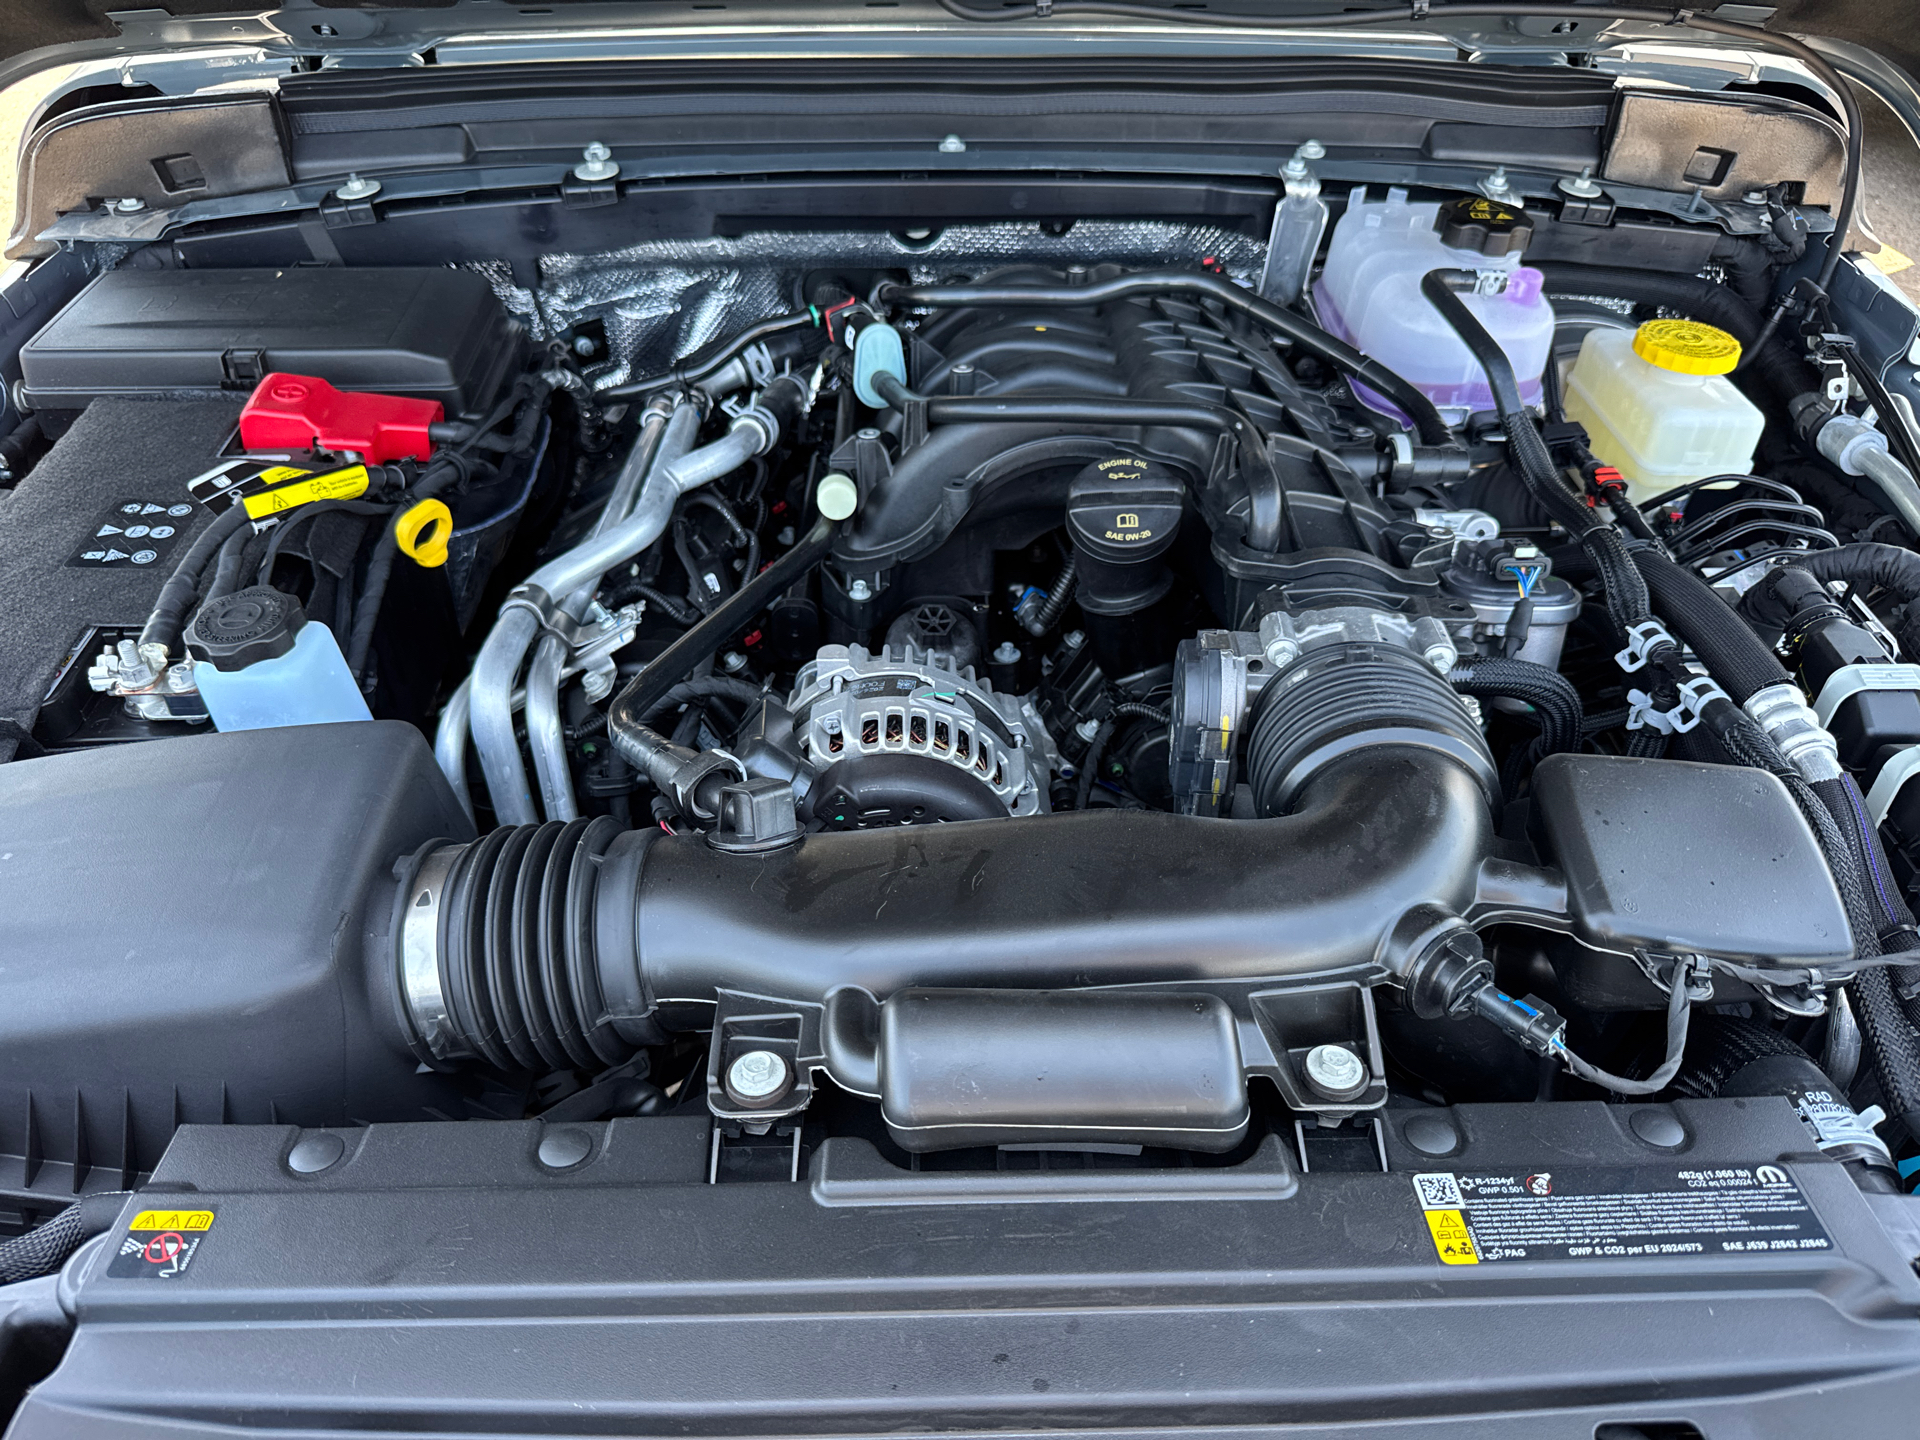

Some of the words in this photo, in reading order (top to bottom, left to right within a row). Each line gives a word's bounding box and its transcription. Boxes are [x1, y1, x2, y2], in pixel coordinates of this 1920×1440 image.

[1097, 458, 1132, 471] ENGINE
[1133, 459, 1148, 470] OIL
[1105, 530, 1124, 541] SAE
[1125, 529, 1152, 541] 0W-20
[1804, 1091, 1833, 1103] RAD
[1474, 1176, 1515, 1186] R-1234yf
[1677, 1171, 1704, 1181] 482g
[1735, 1169, 1752, 1179] lb)
[1688, 1179, 1708, 1188] CO2
[1478, 1186, 1500, 1195] GWP
[1501, 1185, 1525, 1194] 0.501
[1568, 1246, 1592, 1256] GWP
[1594, 1247, 1603, 1255] &
[1604, 1245, 1625, 1255] CO2
[1627, 1245, 1643, 1256] per
[1644, 1244, 1660, 1254] EU
[1660, 1242, 1703, 1253] 2024/573
[1722, 1241, 1745, 1251] SAE
[1746, 1240, 1769, 1251] J639
[1770, 1239, 1799, 1250] J2842
[1799, 1238, 1829, 1249] J2845
[1504, 1248, 1526, 1258] PAG
